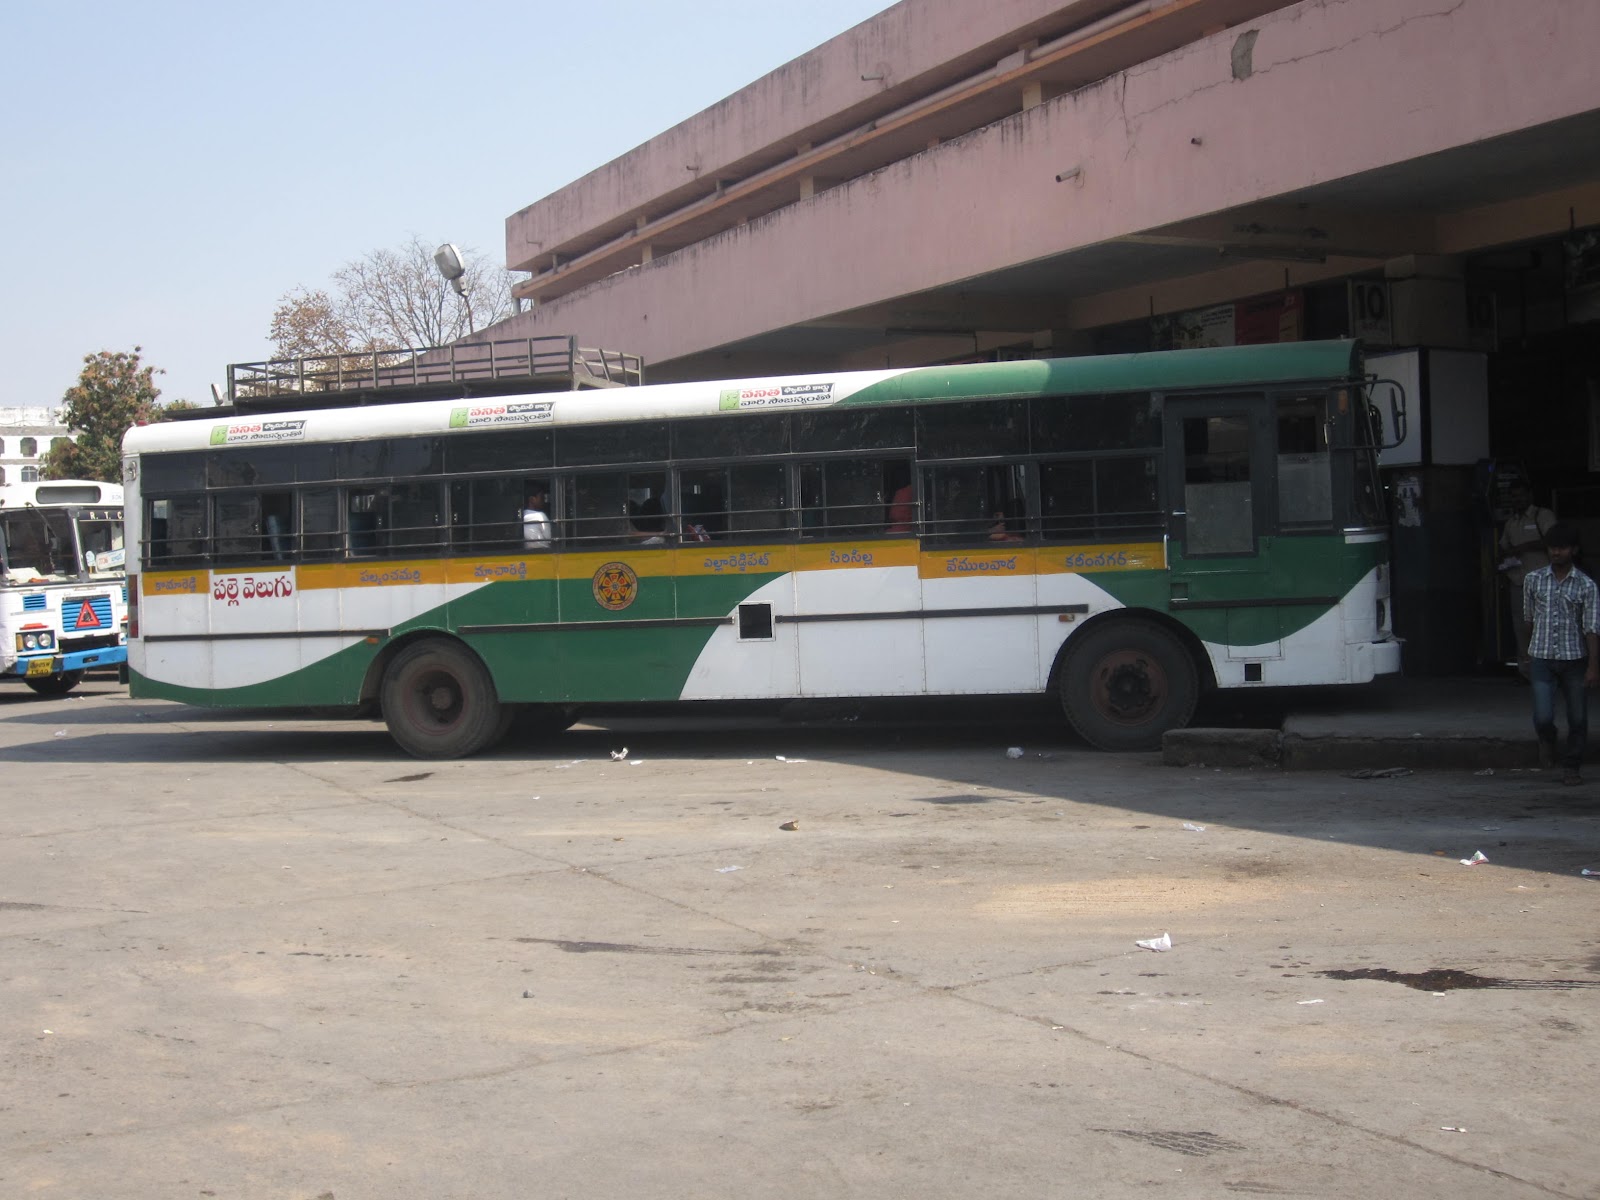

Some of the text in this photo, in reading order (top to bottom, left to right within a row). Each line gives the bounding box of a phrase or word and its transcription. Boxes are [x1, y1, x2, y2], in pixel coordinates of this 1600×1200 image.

[1357, 284, 1385, 320] 10
[830, 549, 874, 566] సిరిసిల్ల
[946, 556, 1018, 573] వేములవాడ
[1065, 551, 1127, 568] కరీంనగర్
[155, 576, 197, 593] కామారెడ్డి
[213, 575, 293, 606] పల్లె వెలుగు
